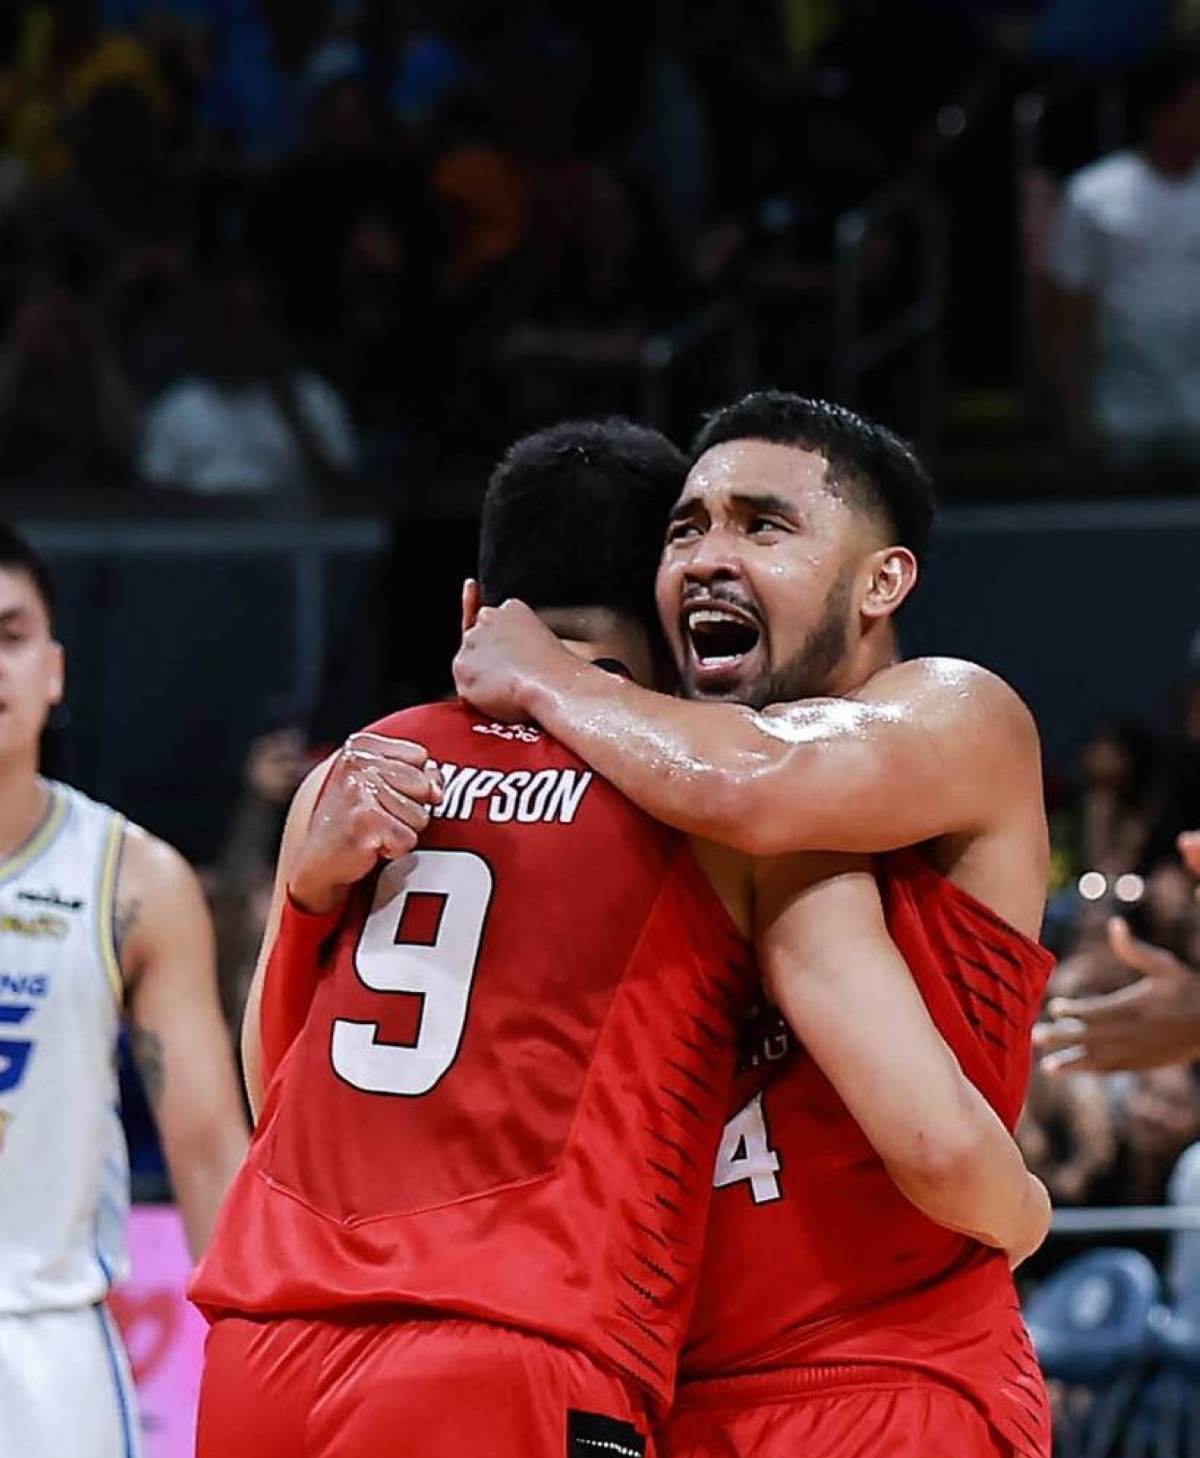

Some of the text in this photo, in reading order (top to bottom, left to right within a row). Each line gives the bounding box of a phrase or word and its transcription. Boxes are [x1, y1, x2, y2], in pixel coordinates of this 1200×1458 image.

[424, 758, 594, 824] MPSON
[331, 849, 494, 1096] 9
[713, 1088, 782, 1205] 4
